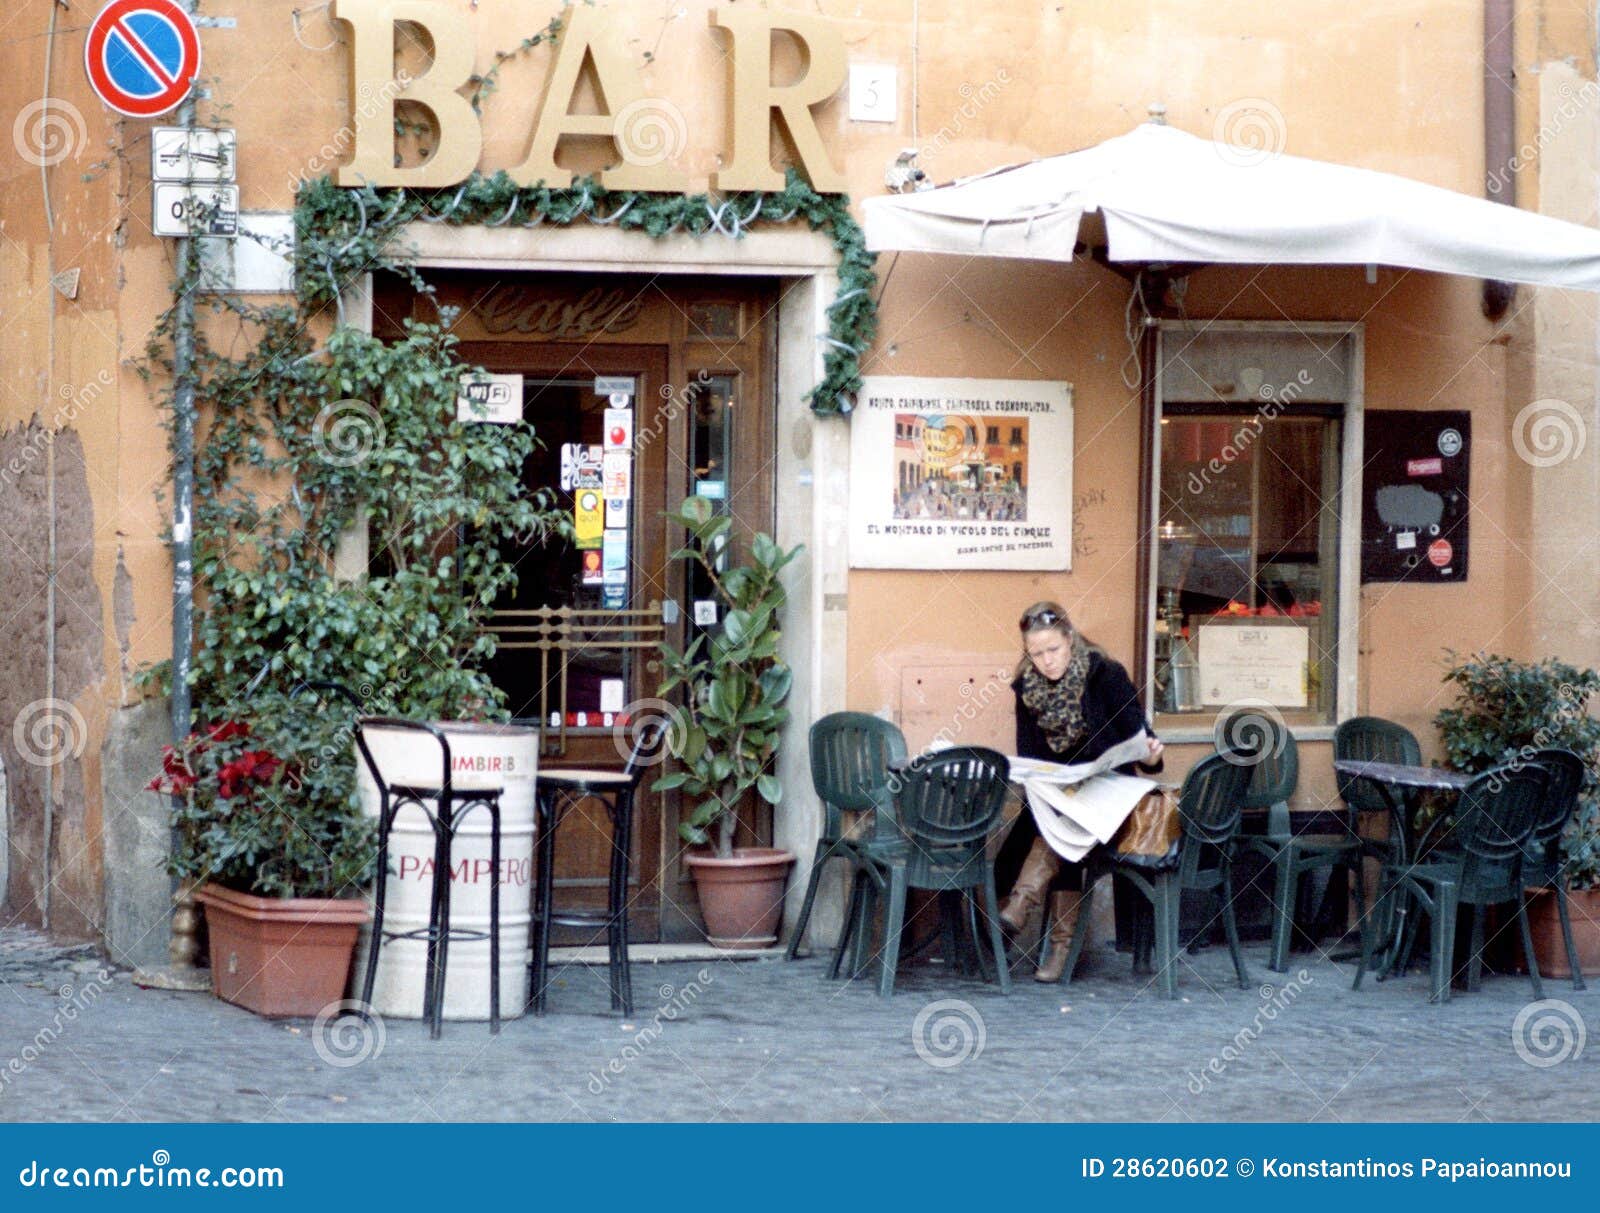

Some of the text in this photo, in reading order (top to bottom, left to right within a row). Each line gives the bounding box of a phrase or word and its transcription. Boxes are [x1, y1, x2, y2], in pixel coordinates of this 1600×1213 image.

[334, 0, 849, 193] BAR
[863, 79, 881, 109] 5
[990, 527, 1010, 537] DEL
